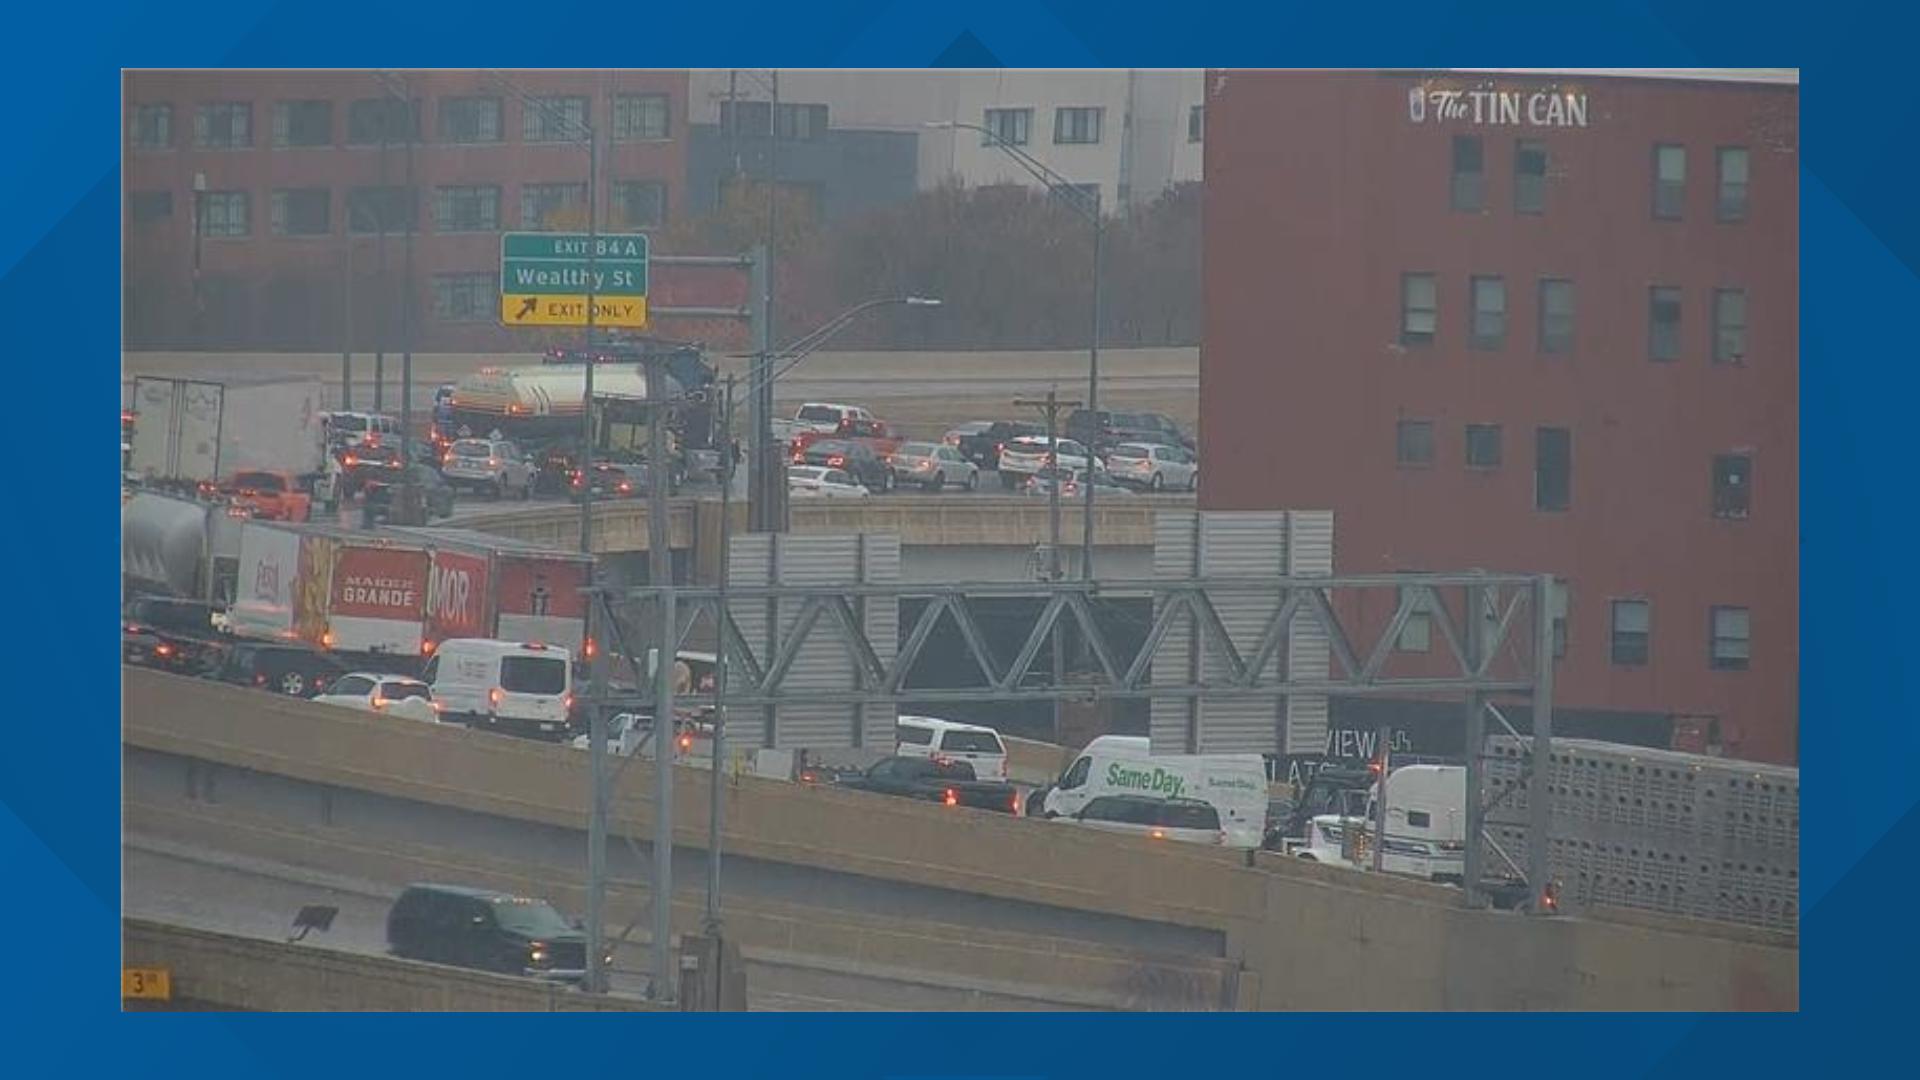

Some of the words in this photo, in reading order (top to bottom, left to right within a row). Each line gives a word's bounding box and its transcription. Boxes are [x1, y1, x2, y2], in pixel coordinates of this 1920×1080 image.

[1428, 90, 1469, 122] The
[1468, 91, 1521, 124] TIN
[1527, 92, 1588, 127] CAN
[554, 239, 588, 254] EXIT
[624, 240, 638, 256] A
[516, 268, 605, 290] Wealthy
[613, 270, 634, 287] St
[548, 302, 583, 317] EXIT
[343, 587, 414, 607] GRANDE
